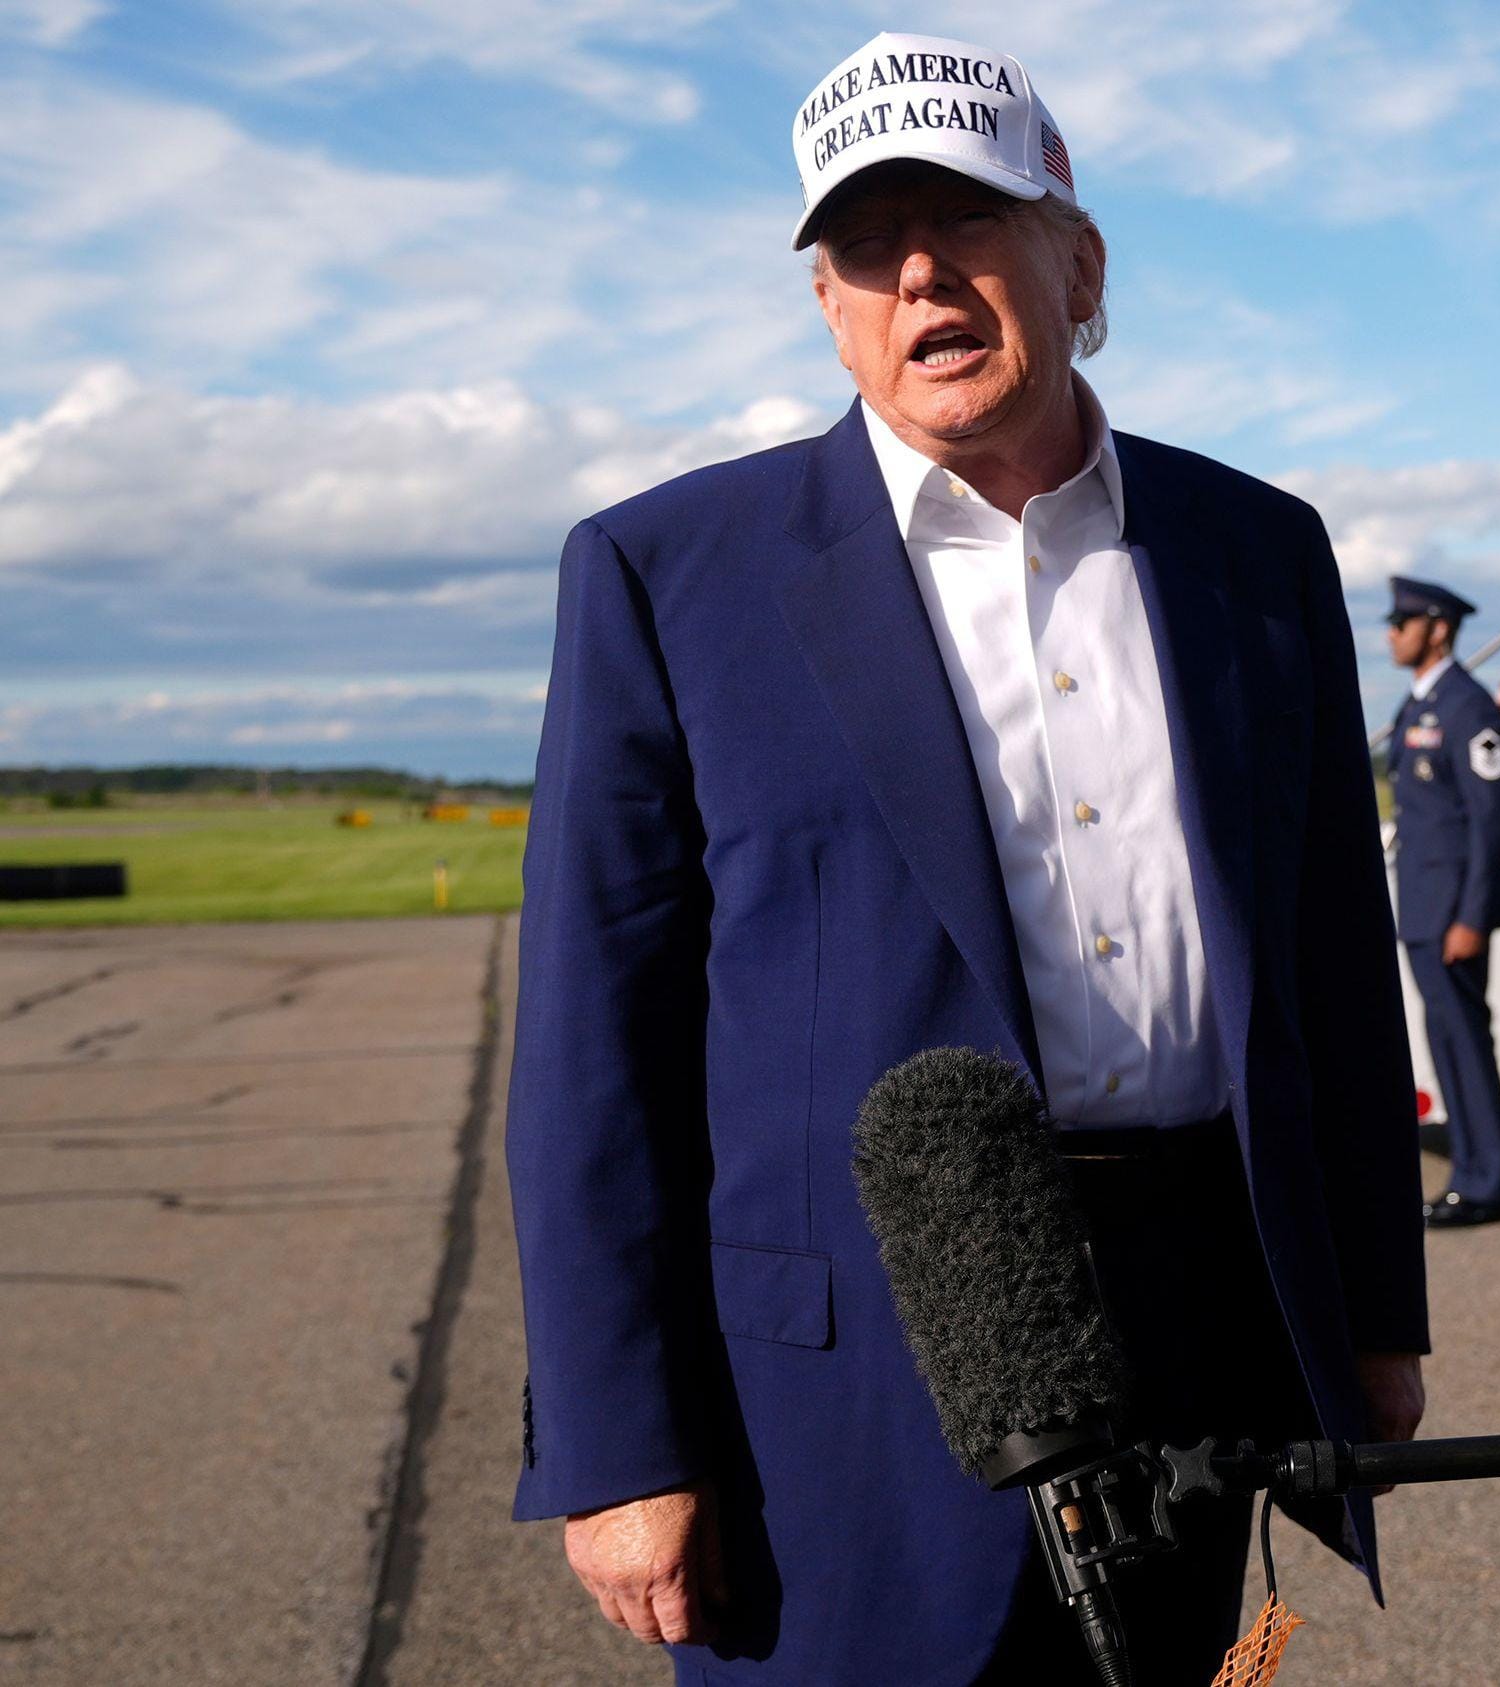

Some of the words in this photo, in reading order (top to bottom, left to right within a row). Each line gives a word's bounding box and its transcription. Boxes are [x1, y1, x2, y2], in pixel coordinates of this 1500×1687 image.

[801, 66, 863, 138] MAKE
[867, 53, 1016, 97] AMERICA
[814, 102, 893, 172] GREAT
[900, 97, 999, 141] AGAIN
